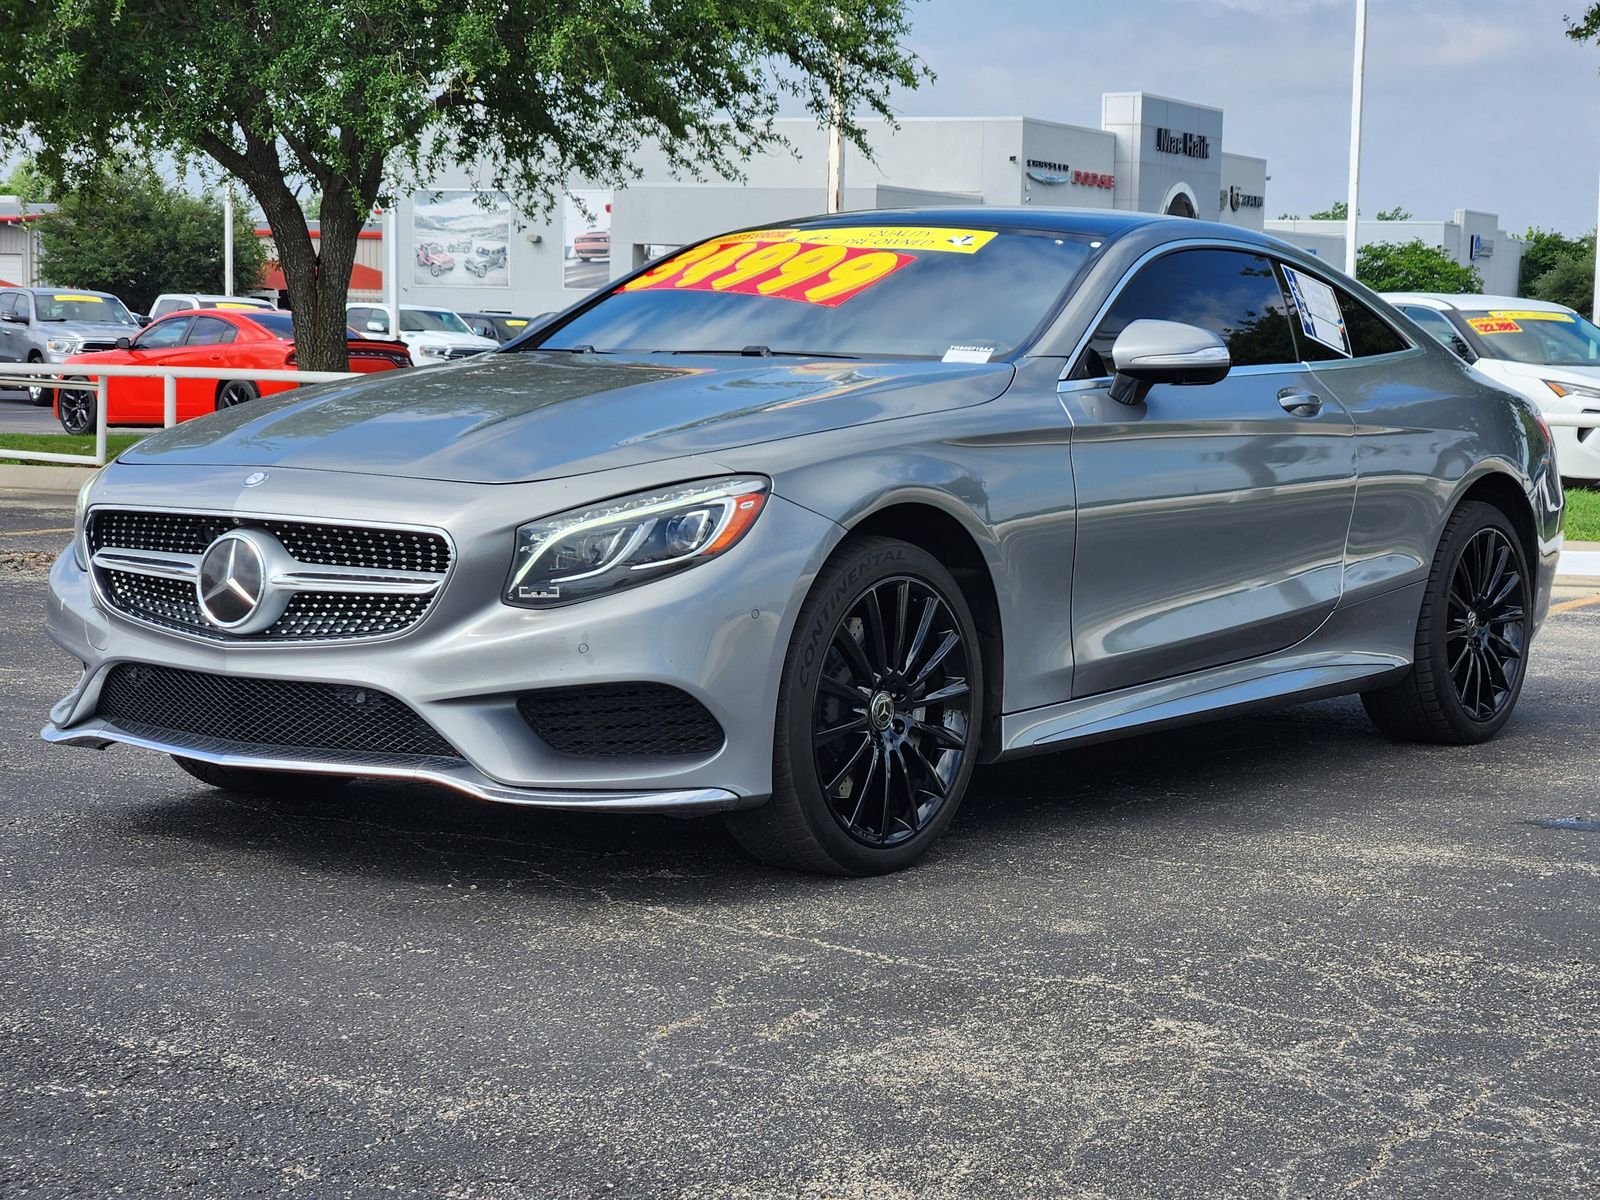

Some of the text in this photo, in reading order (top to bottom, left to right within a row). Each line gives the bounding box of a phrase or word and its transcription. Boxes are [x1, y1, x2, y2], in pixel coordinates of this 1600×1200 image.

[1157, 128, 1209, 159] Mac Haik
[1073, 170, 1115, 189] DODGE
[843, 237, 935, 246] PRE-OWNED
[868, 230, 935, 238] QUALITY
[801, 550, 904, 688] CONTINENTAL
